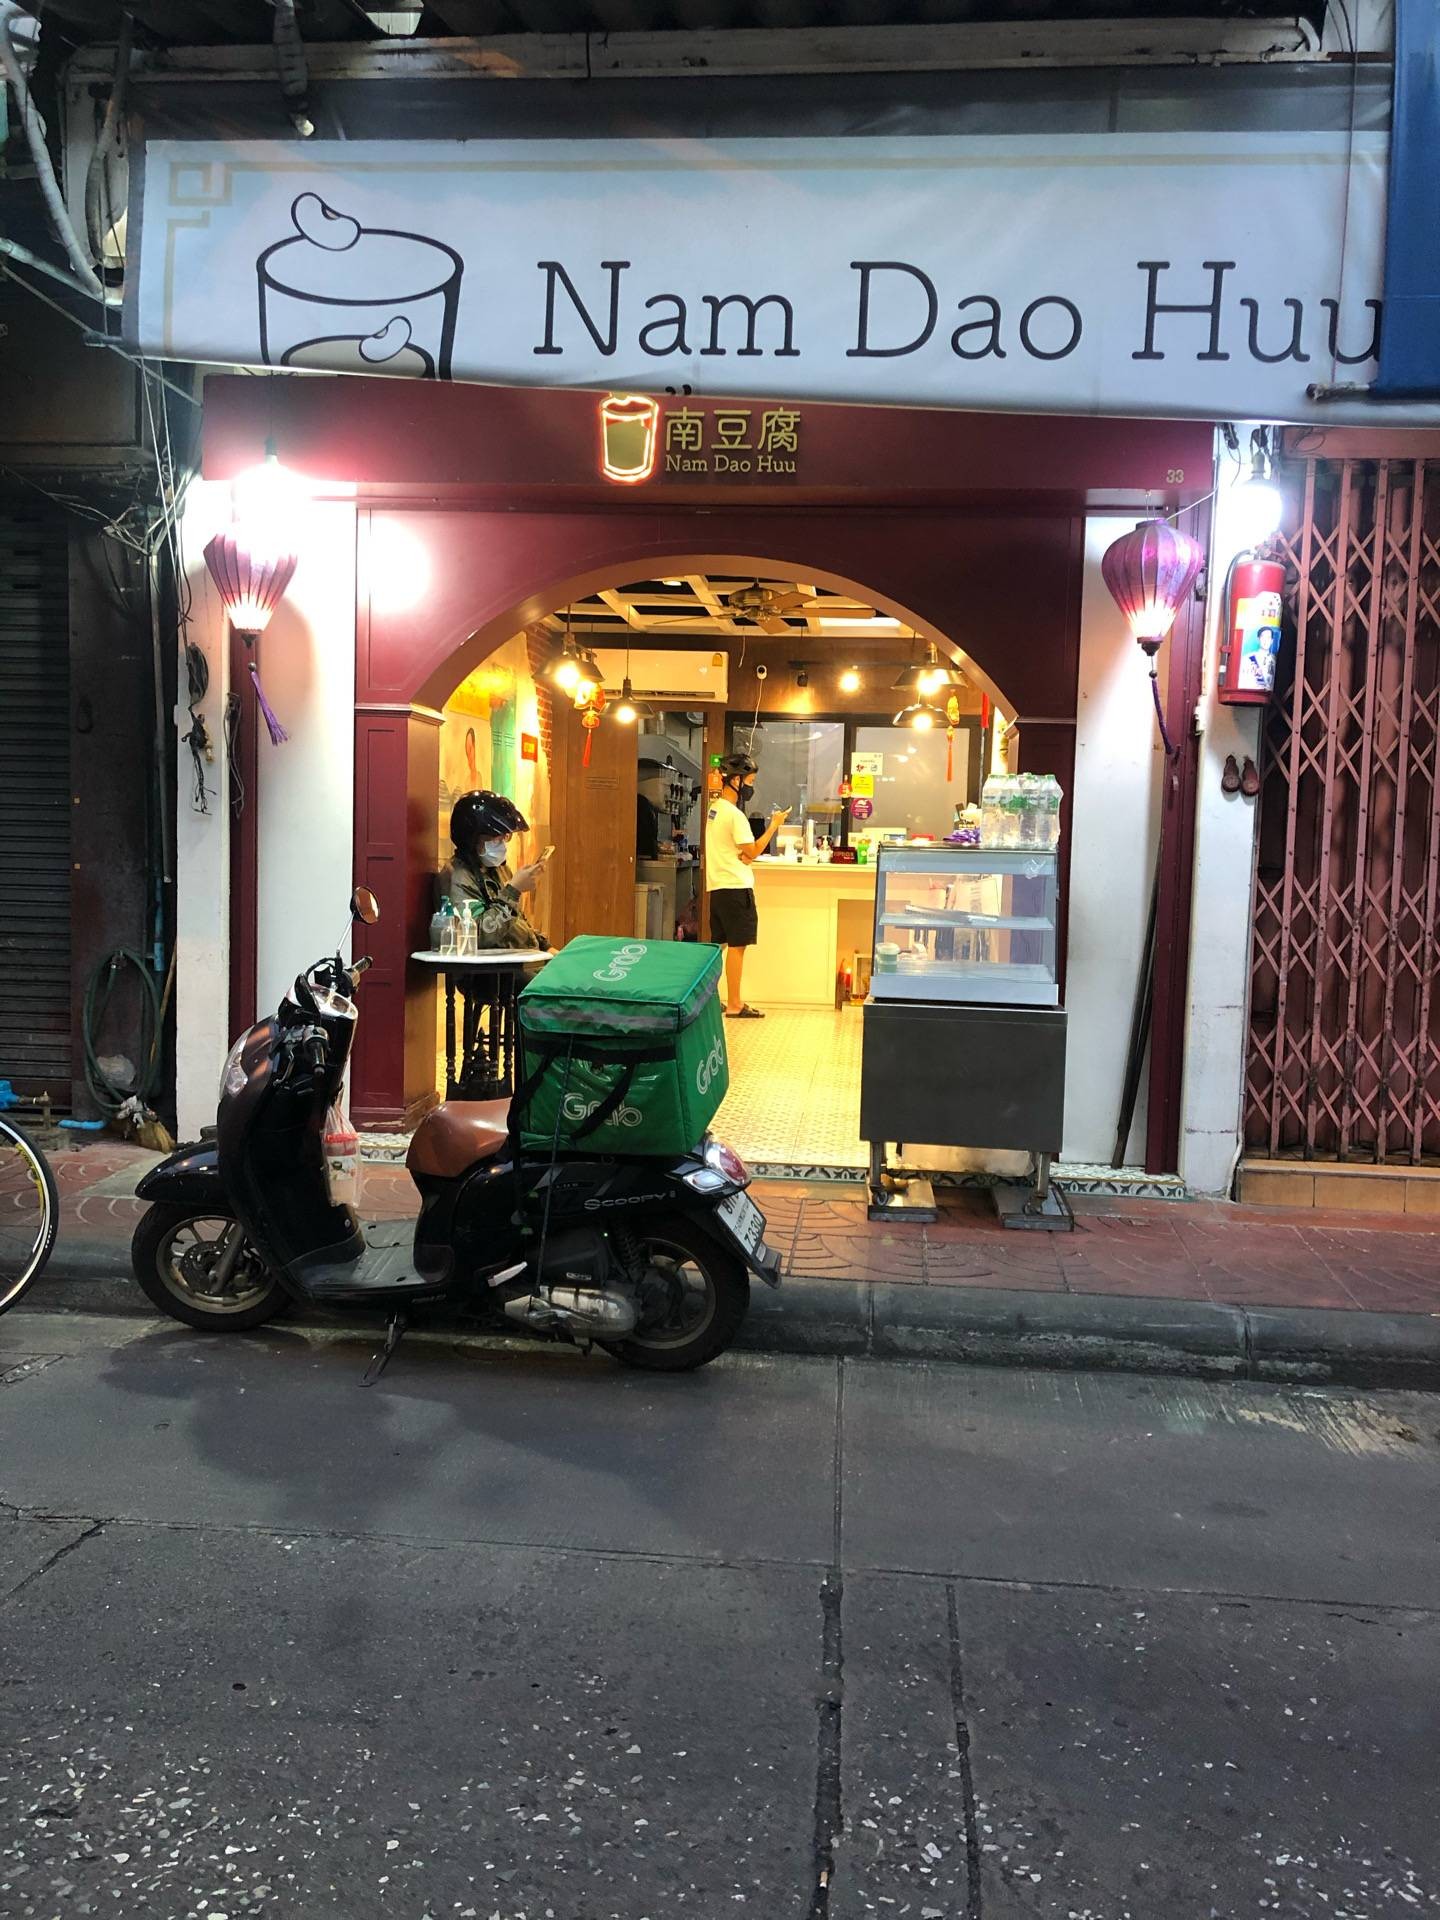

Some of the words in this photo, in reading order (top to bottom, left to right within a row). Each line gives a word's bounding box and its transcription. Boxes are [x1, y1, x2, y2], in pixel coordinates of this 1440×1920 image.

[533, 260, 801, 356] Nam
[846, 261, 1083, 361] Dao
[1132, 261, 1383, 365] Huu
[664, 406, 801, 453] 南豆腐
[665, 455, 708, 472] Nam
[714, 455, 751, 473] Dao
[757, 455, 796, 473] Huu
[1166, 469, 1184, 484] 33
[592, 944, 648, 982] Grab
[696, 1034, 724, 1096] Grab
